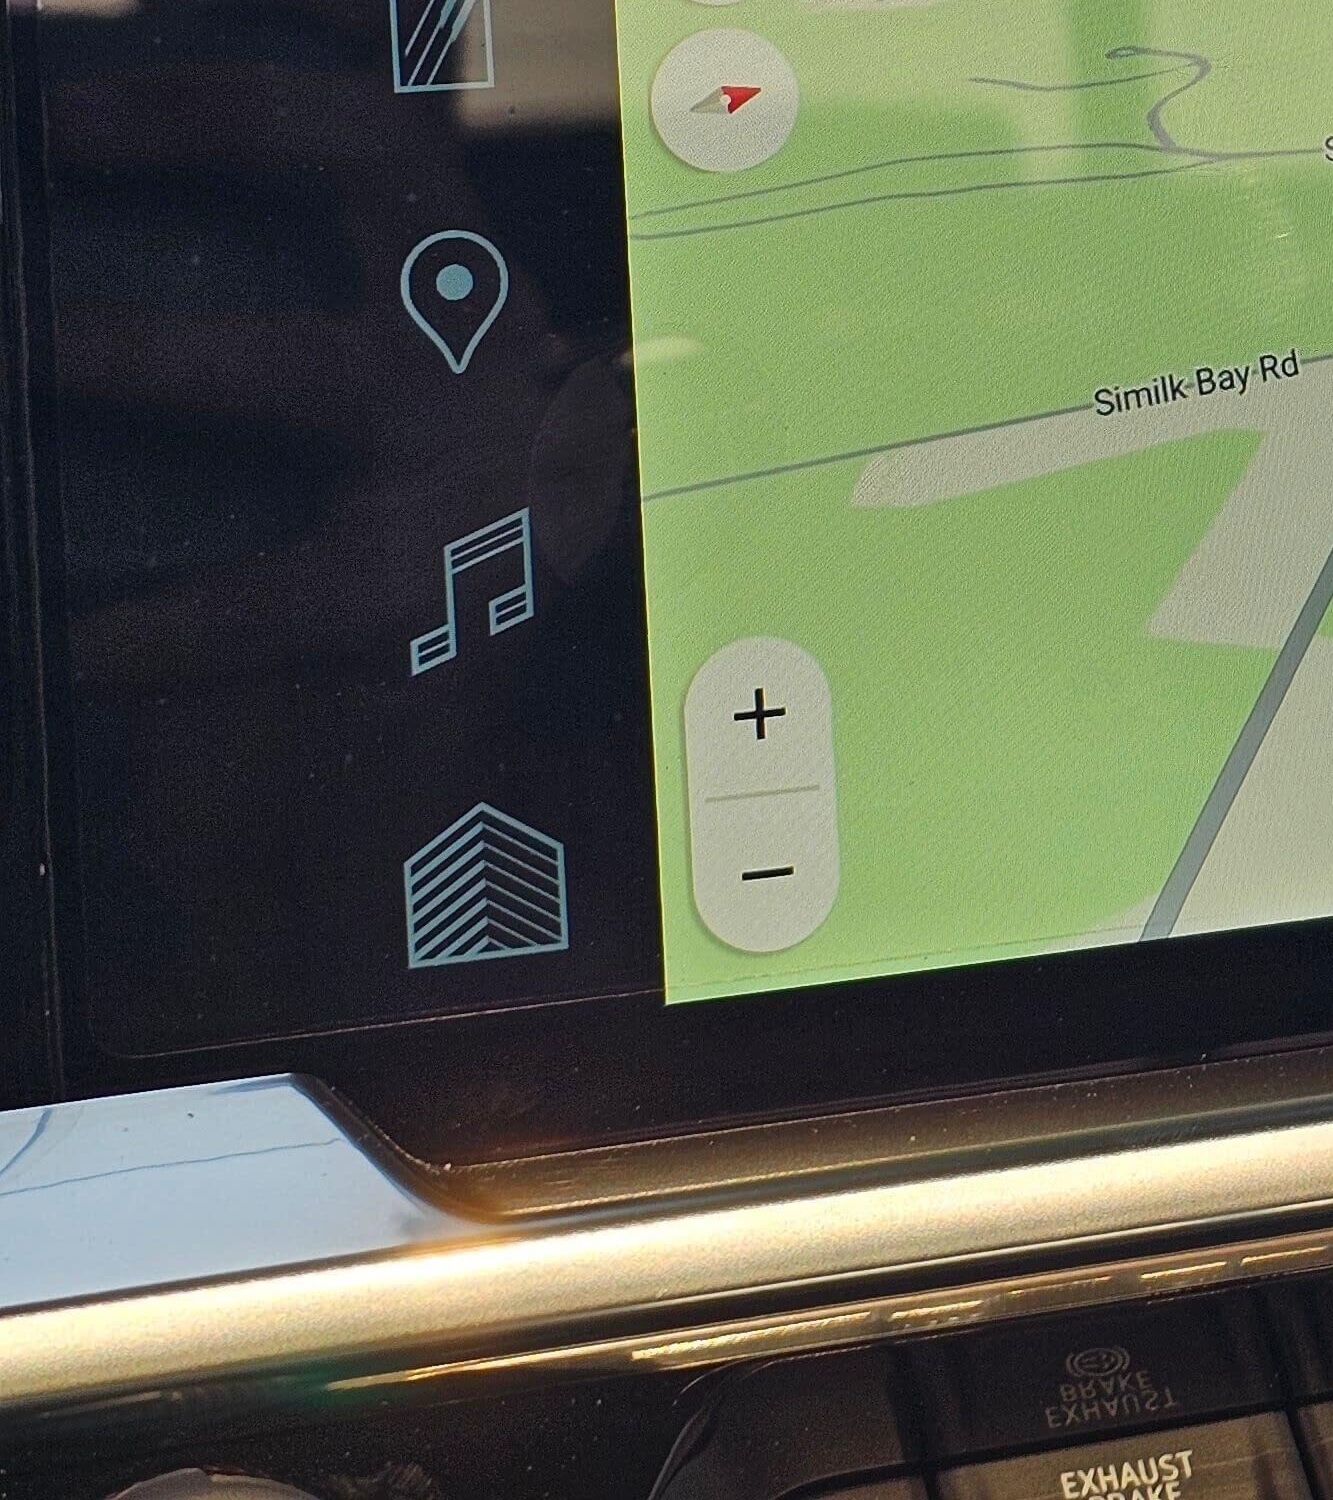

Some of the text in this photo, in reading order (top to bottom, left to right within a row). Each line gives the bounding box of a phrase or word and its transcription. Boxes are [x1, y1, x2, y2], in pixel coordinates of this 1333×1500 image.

[1094, 348, 1300, 417] Similk Bay Rd
[1060, 1450, 1193, 1500] EXHAUST
